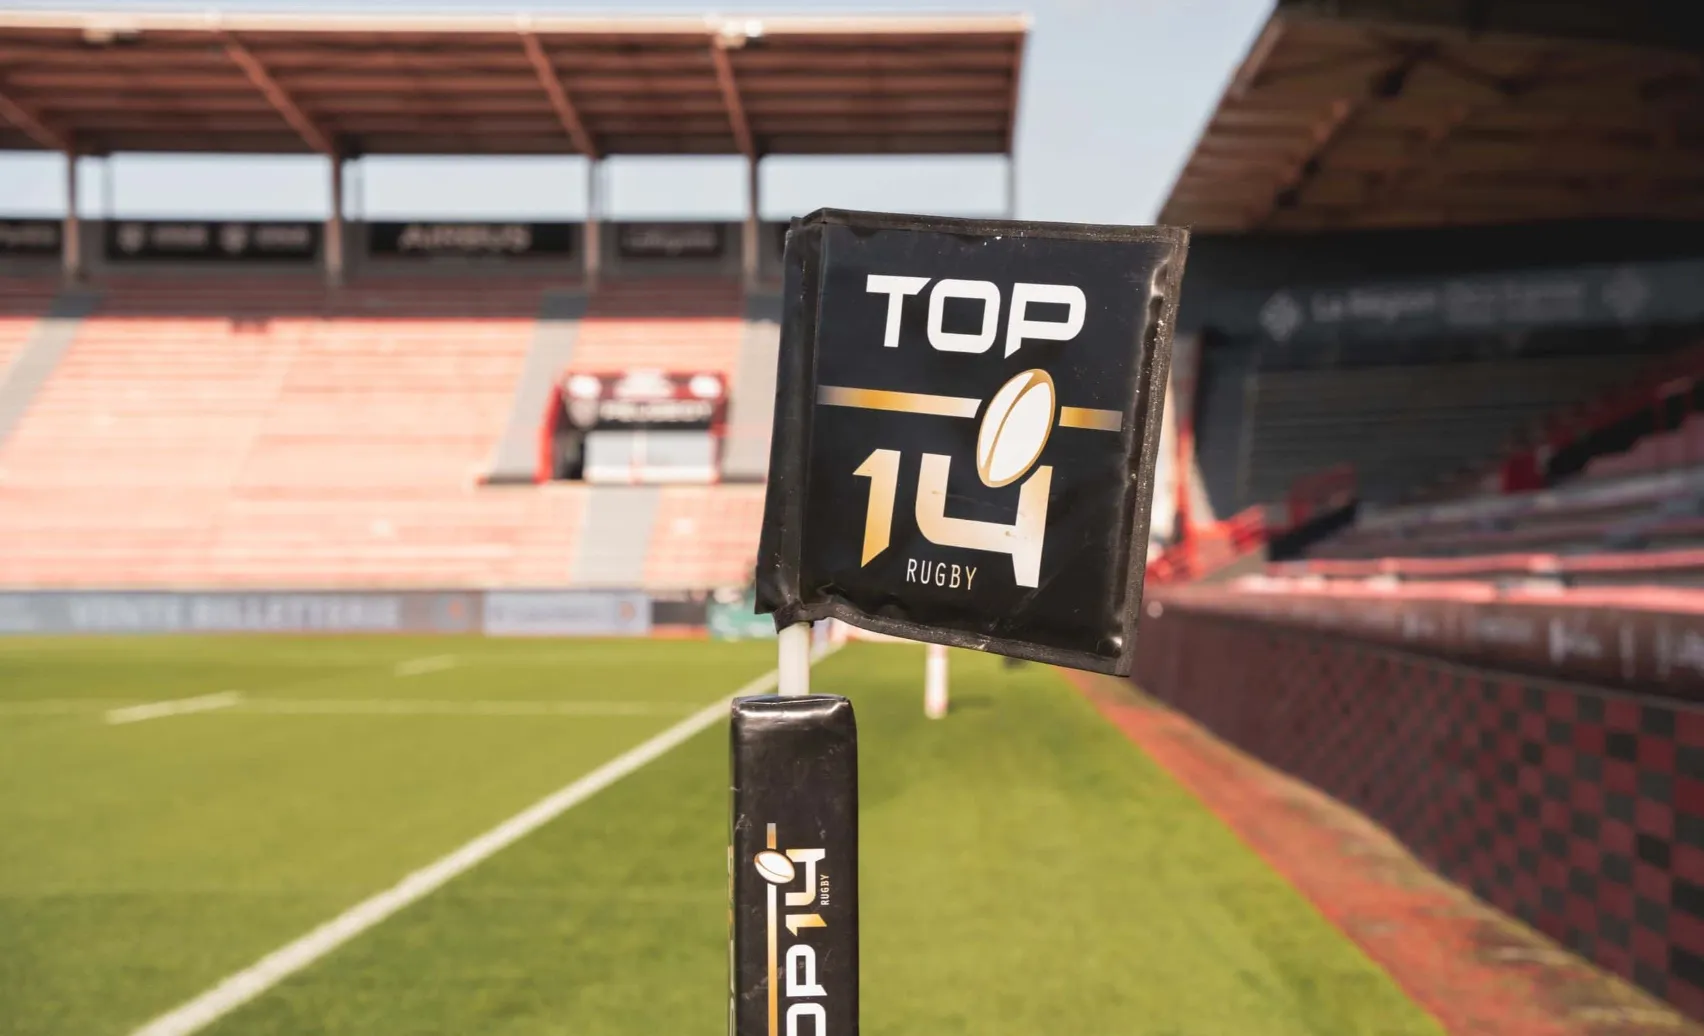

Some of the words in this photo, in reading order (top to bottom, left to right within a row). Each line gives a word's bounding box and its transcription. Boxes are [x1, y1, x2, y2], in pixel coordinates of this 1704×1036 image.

[866, 274, 1086, 359] TOP
[852, 448, 1053, 588] 14
[906, 558, 977, 590] RUGBY
[785, 848, 827, 937] 14
[820, 874, 829, 905] RUGBY
